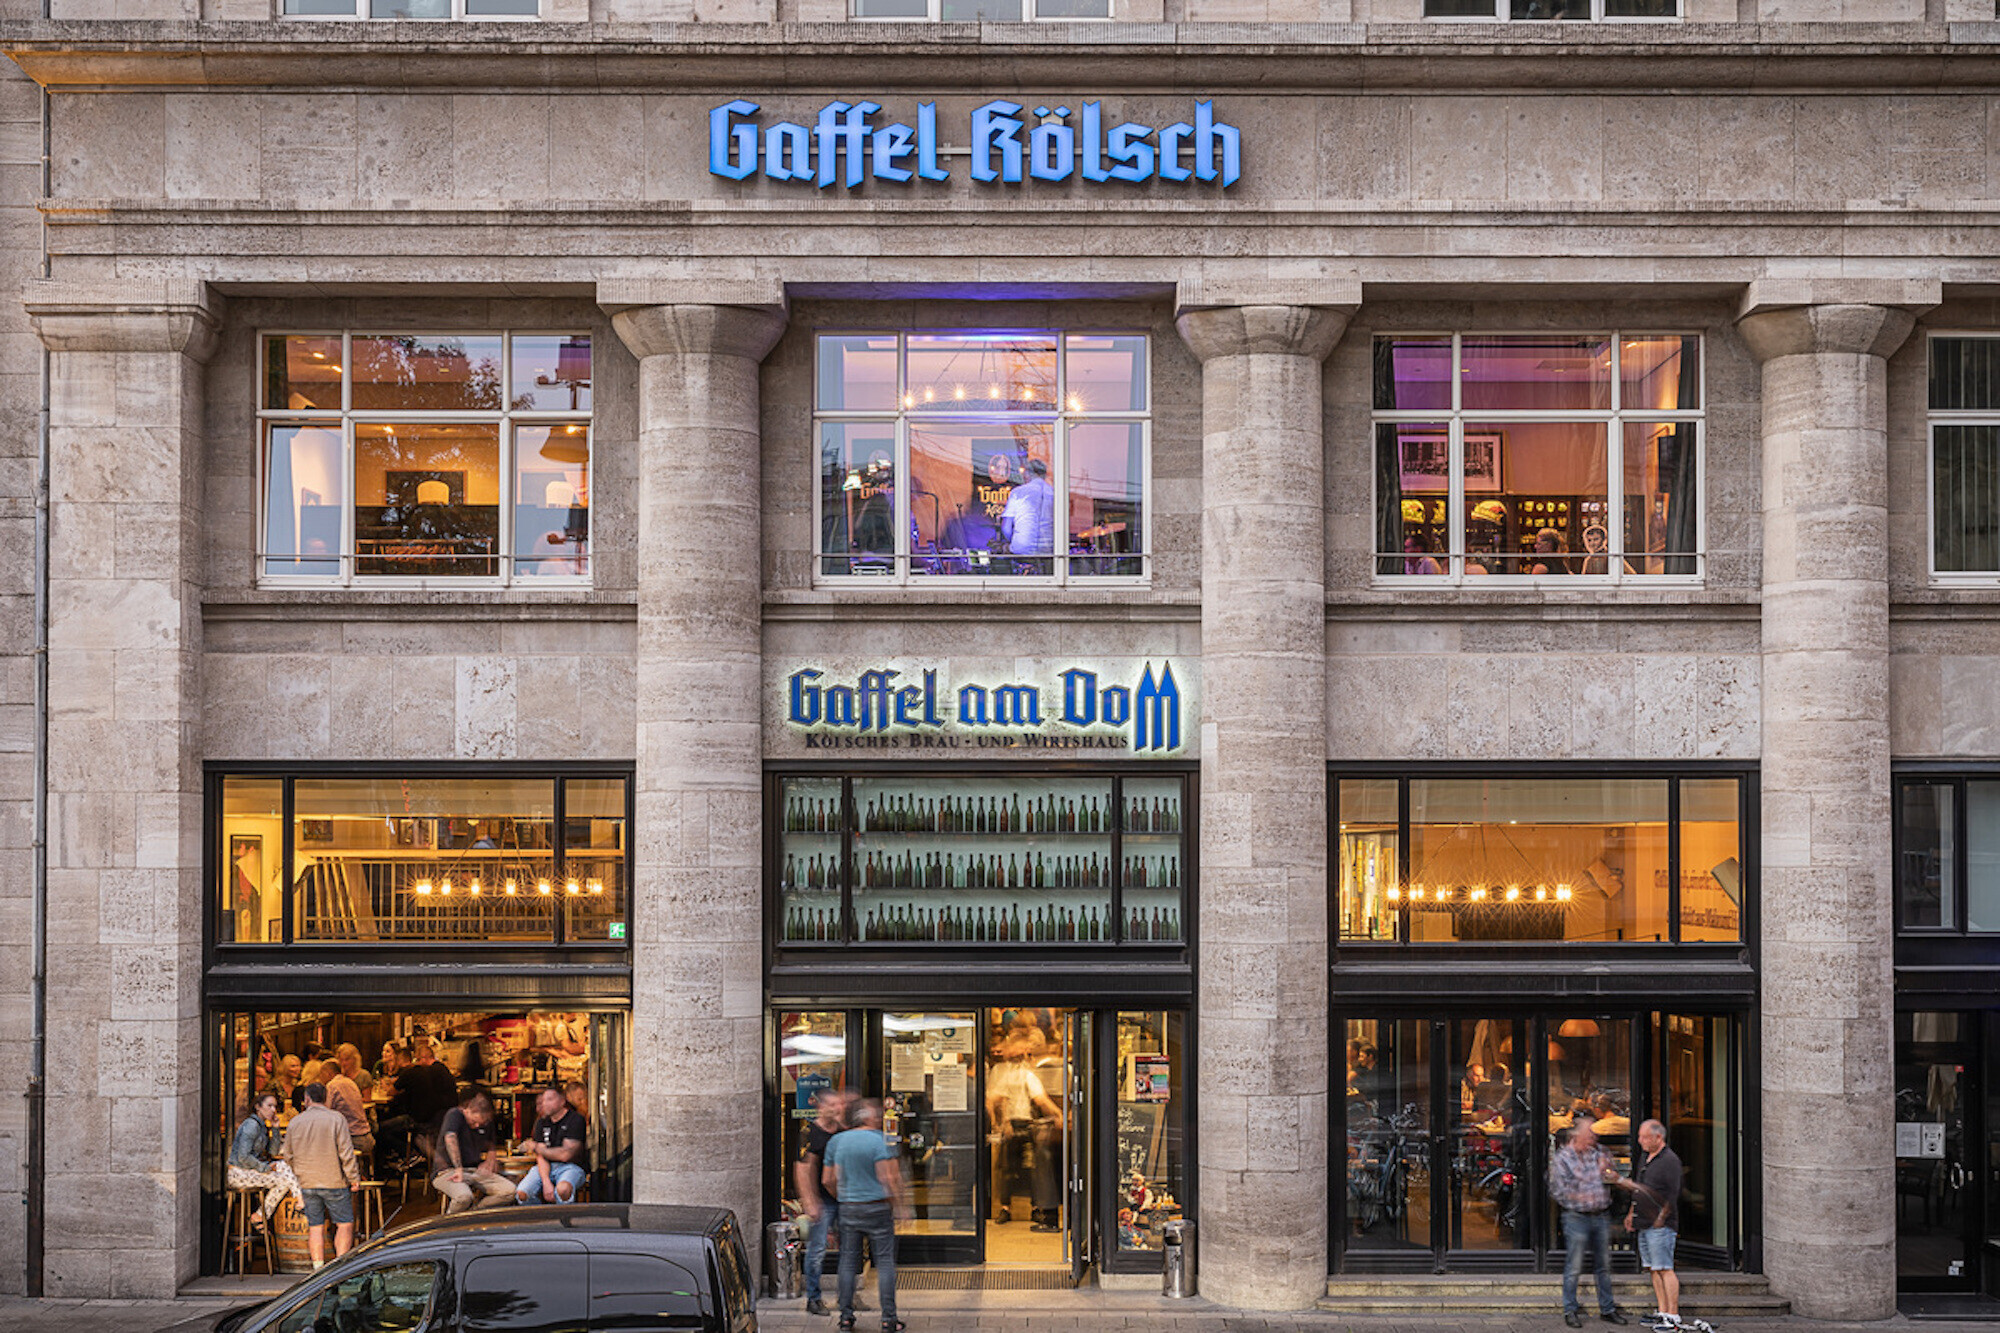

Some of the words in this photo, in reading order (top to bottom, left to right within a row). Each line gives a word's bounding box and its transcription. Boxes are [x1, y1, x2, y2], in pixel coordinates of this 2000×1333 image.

[710, 100, 950, 188] Gaffel
[971, 100, 1240, 188] Kölsch
[787, 667, 947, 734] Gaffel
[957, 682, 1045, 727] am
